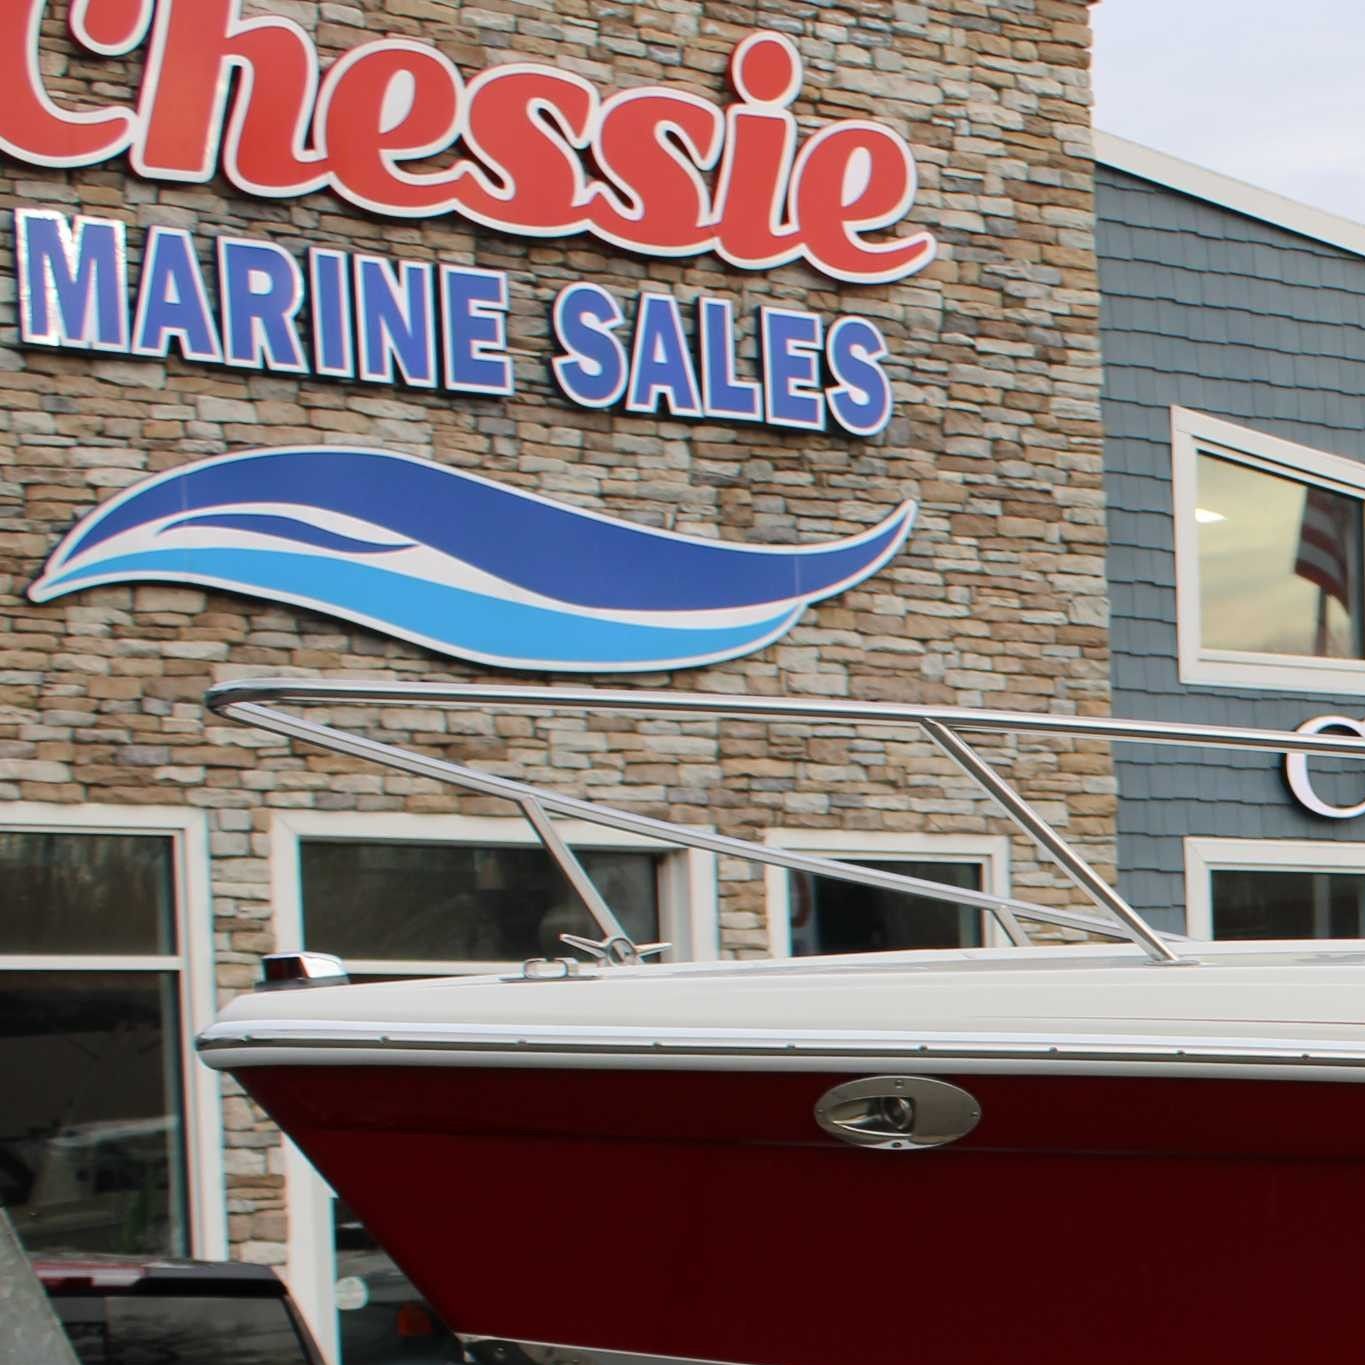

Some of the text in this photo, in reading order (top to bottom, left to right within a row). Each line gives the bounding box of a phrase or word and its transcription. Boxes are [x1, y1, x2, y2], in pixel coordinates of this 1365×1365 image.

[0, 0, 937, 284] Chessie
[13, 207, 894, 437] MARINE SALES
